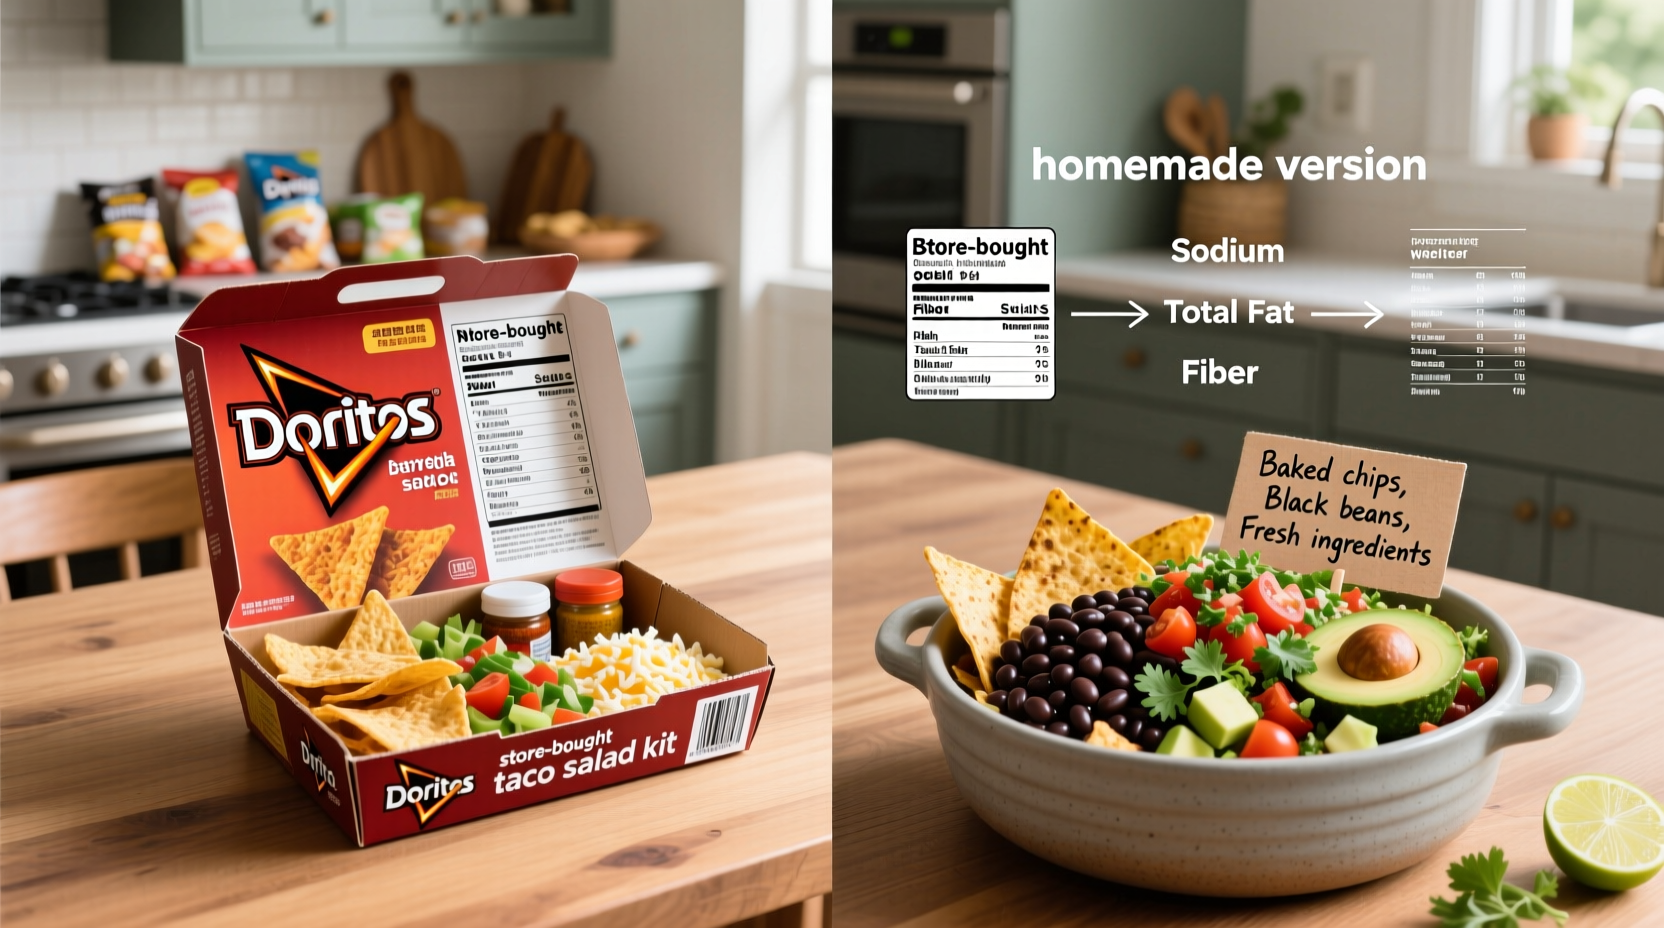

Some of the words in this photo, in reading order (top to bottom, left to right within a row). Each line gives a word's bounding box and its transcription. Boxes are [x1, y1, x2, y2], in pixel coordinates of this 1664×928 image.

[235, 396, 436, 462] Doritos
[1259, 449, 1334, 482] Baked
[1342, 460, 1406, 499] chips,
[1264, 484, 1328, 516] Black
[1339, 494, 1410, 533] beans,
[1240, 515, 1300, 546] Fresh
[1310, 528, 1432, 567] ingredients
[494, 764, 556, 794] taco
[562, 739, 637, 779] salad
[642, 731, 678, 761] kit
[499, 729, 614, 768] store-bought
[385, 775, 475, 810] Doritos
